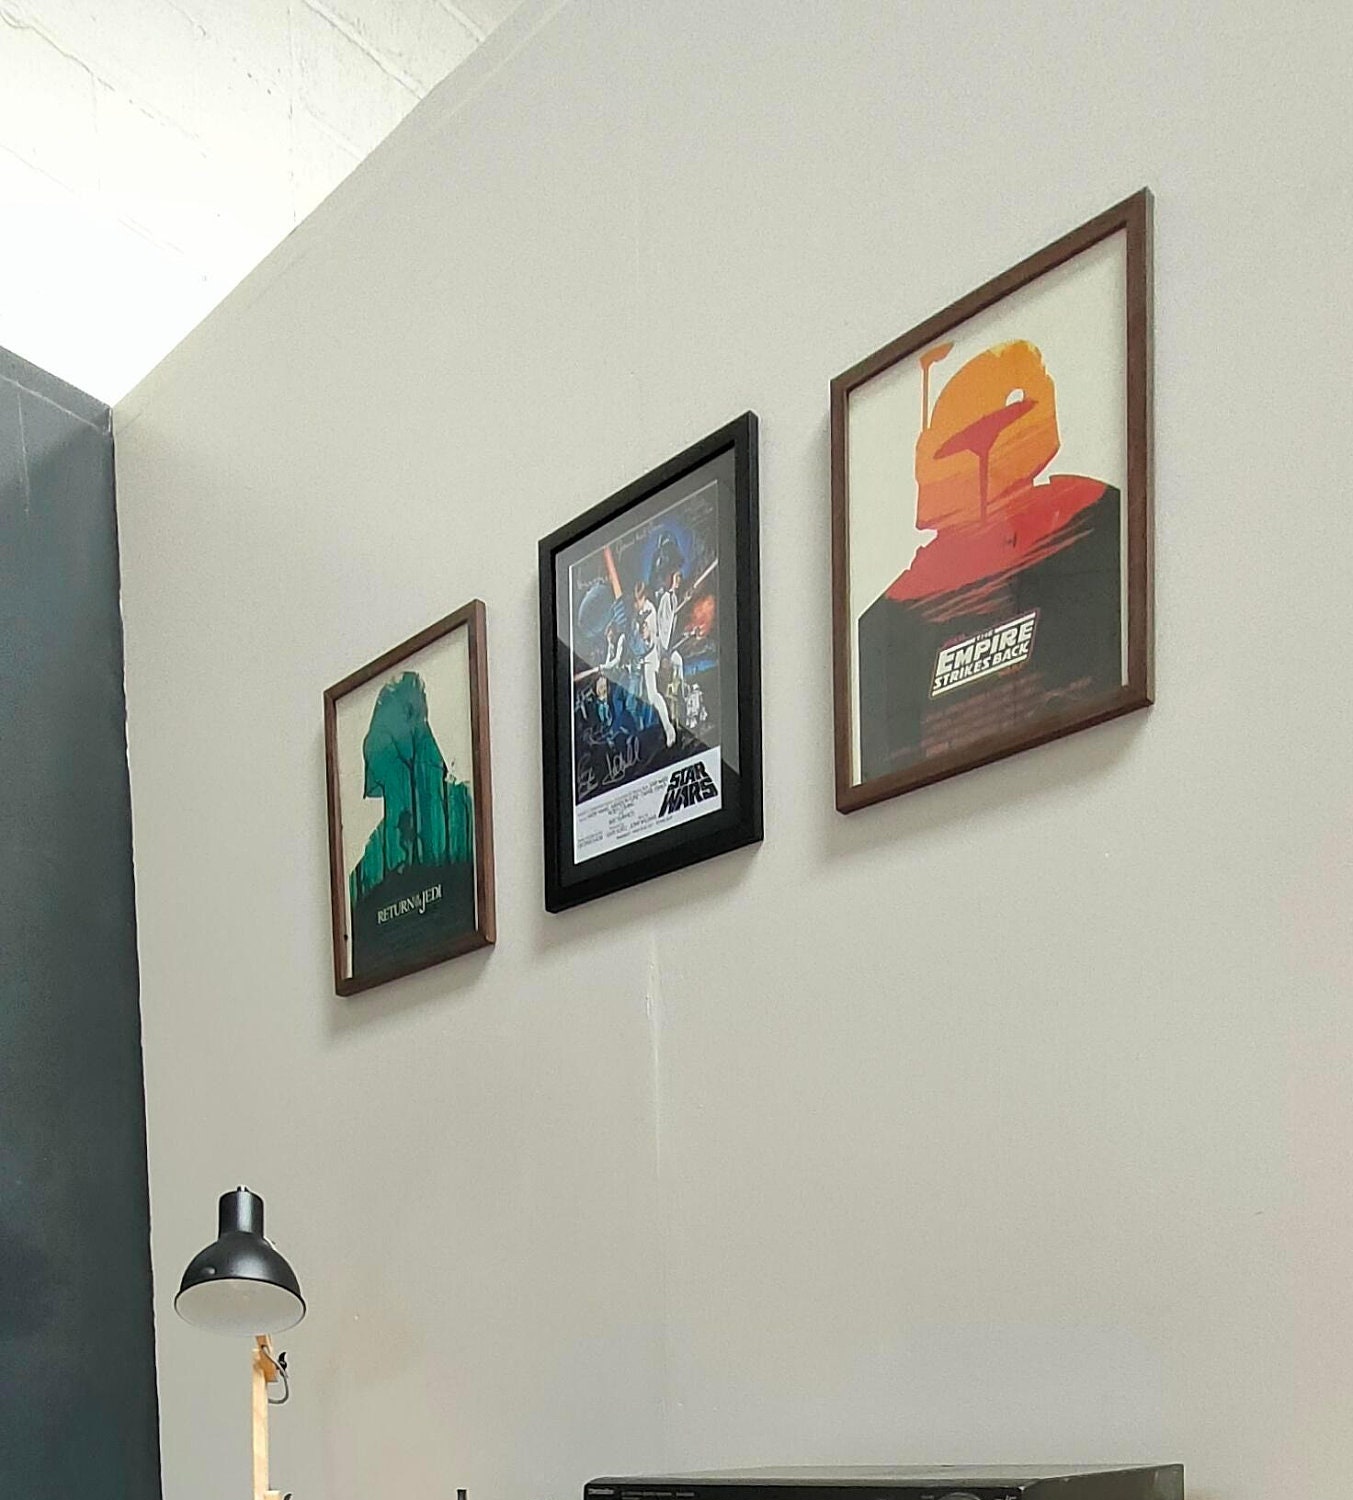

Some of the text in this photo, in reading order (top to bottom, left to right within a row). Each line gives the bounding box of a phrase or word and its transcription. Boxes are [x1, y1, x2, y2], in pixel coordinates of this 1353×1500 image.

[933, 640, 1030, 690] STRIKES BACK
[936, 619, 1034, 677] EMPIRE
[670, 761, 712, 788] STAR
[658, 777, 718, 818] WARS
[377, 898, 415, 925] RETURN
[419, 884, 442, 914] JEDI
